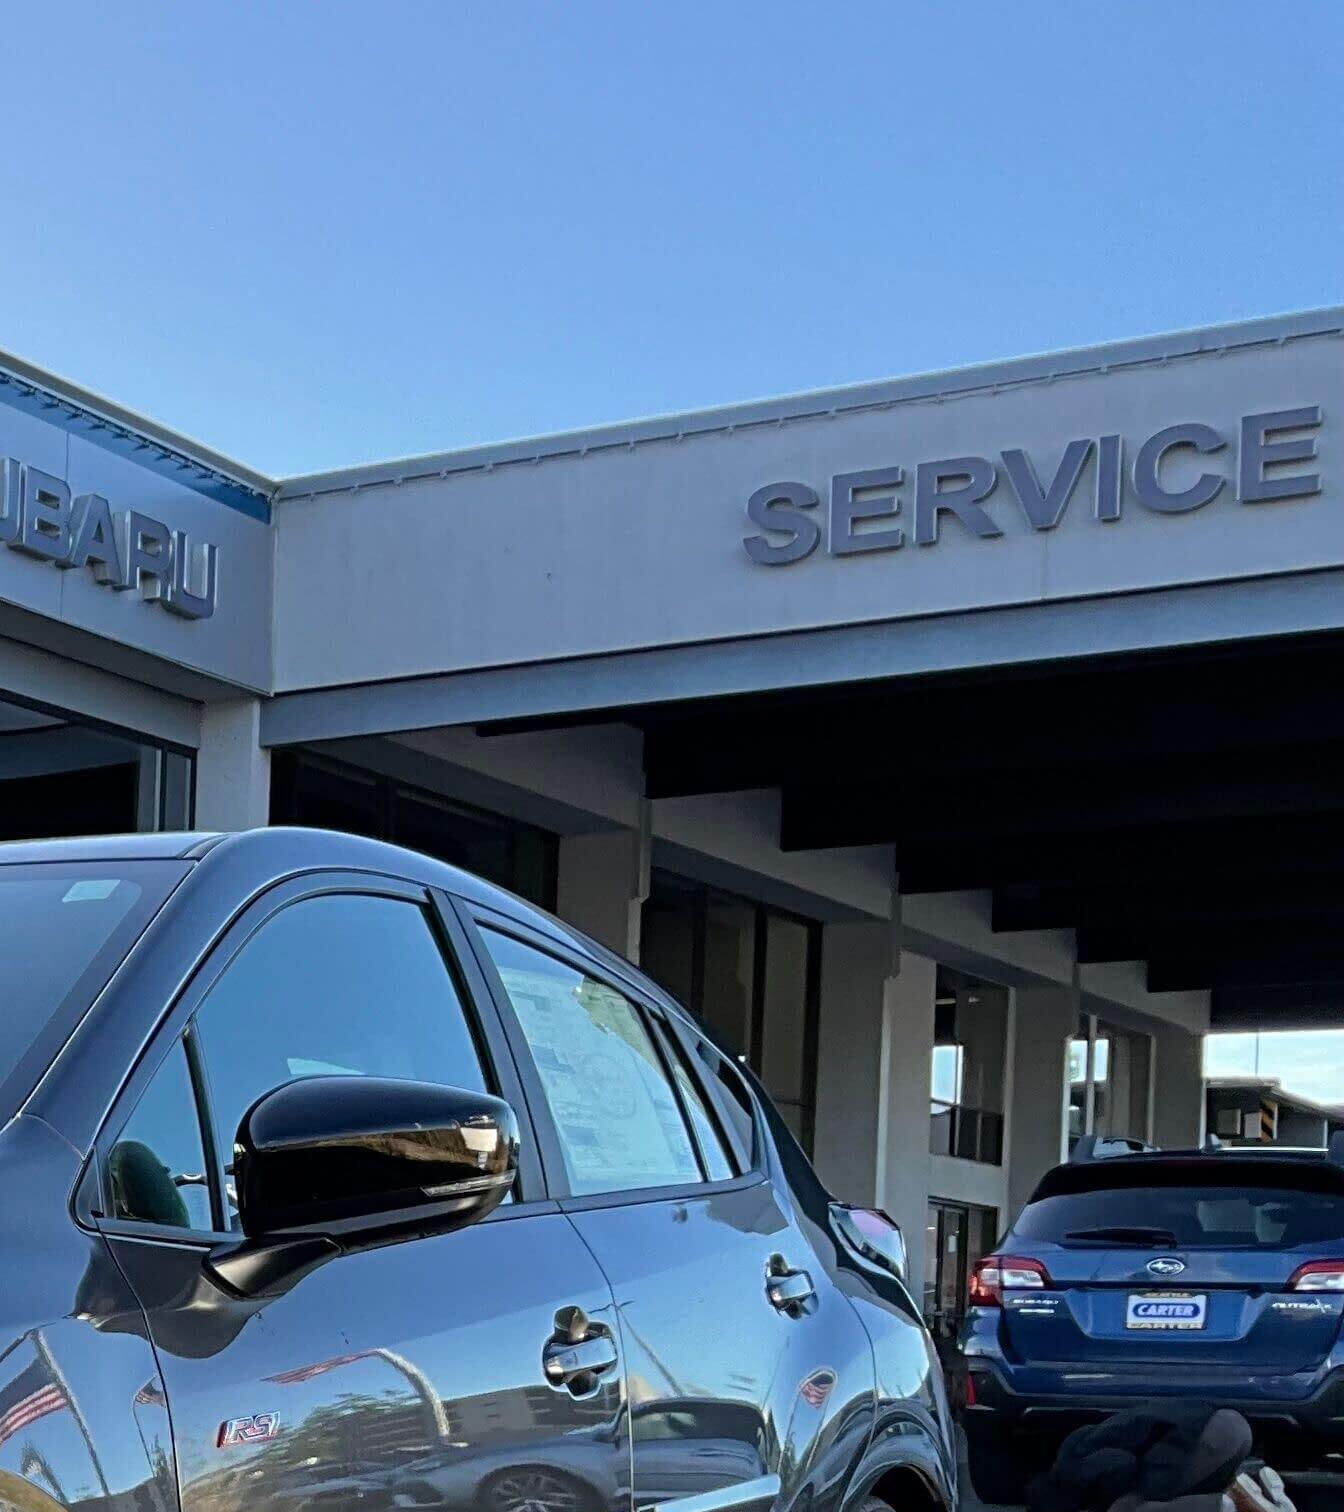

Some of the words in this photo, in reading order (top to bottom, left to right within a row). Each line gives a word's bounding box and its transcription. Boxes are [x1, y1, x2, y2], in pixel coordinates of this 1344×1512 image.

[742, 406, 1324, 567] SERVICE
[1137, 1304, 1194, 1316] CARTER
[223, 1411, 274, 1443] RS
